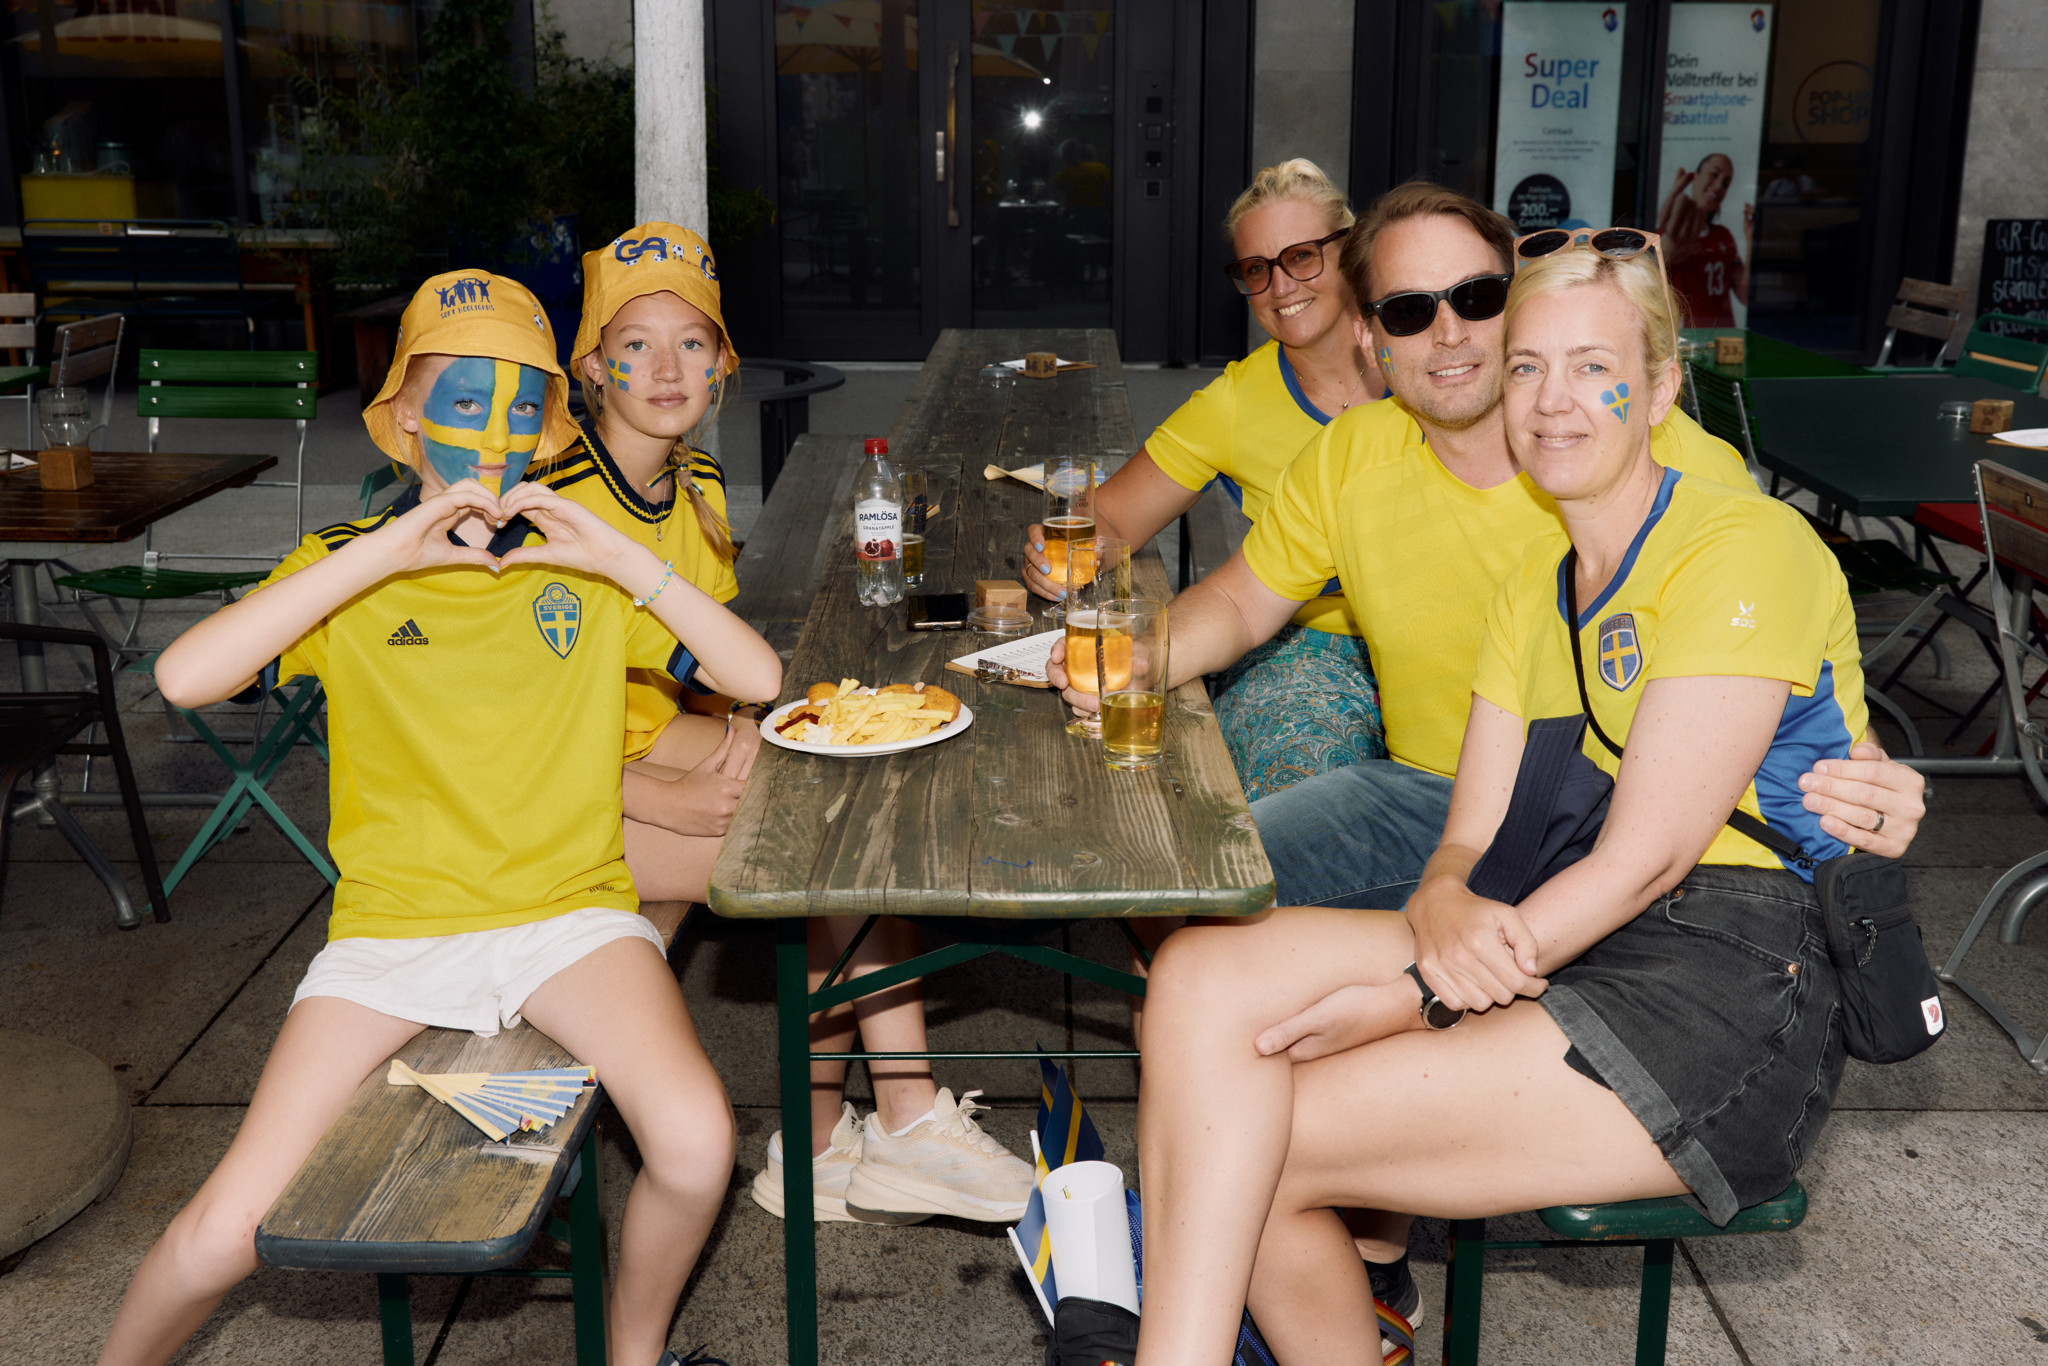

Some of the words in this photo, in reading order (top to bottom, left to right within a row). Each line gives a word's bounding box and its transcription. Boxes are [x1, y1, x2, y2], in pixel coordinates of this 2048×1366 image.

[1667, 54, 1698, 67] Dein
[1524, 52, 1599, 86] Super
[1665, 73, 1734, 86] Volltreffer
[1737, 73, 1758, 86] bei
[1531, 82, 1589, 109] Deal
[1808, 106, 1868, 125] SHOP
[1704, 261, 1725, 296] 13
[441, 309, 455, 319] SOFT
[458, 304, 495, 314] HOOLIGANS
[859, 510, 898, 521] RAMLÖSA
[387, 636, 429, 646] adidas
